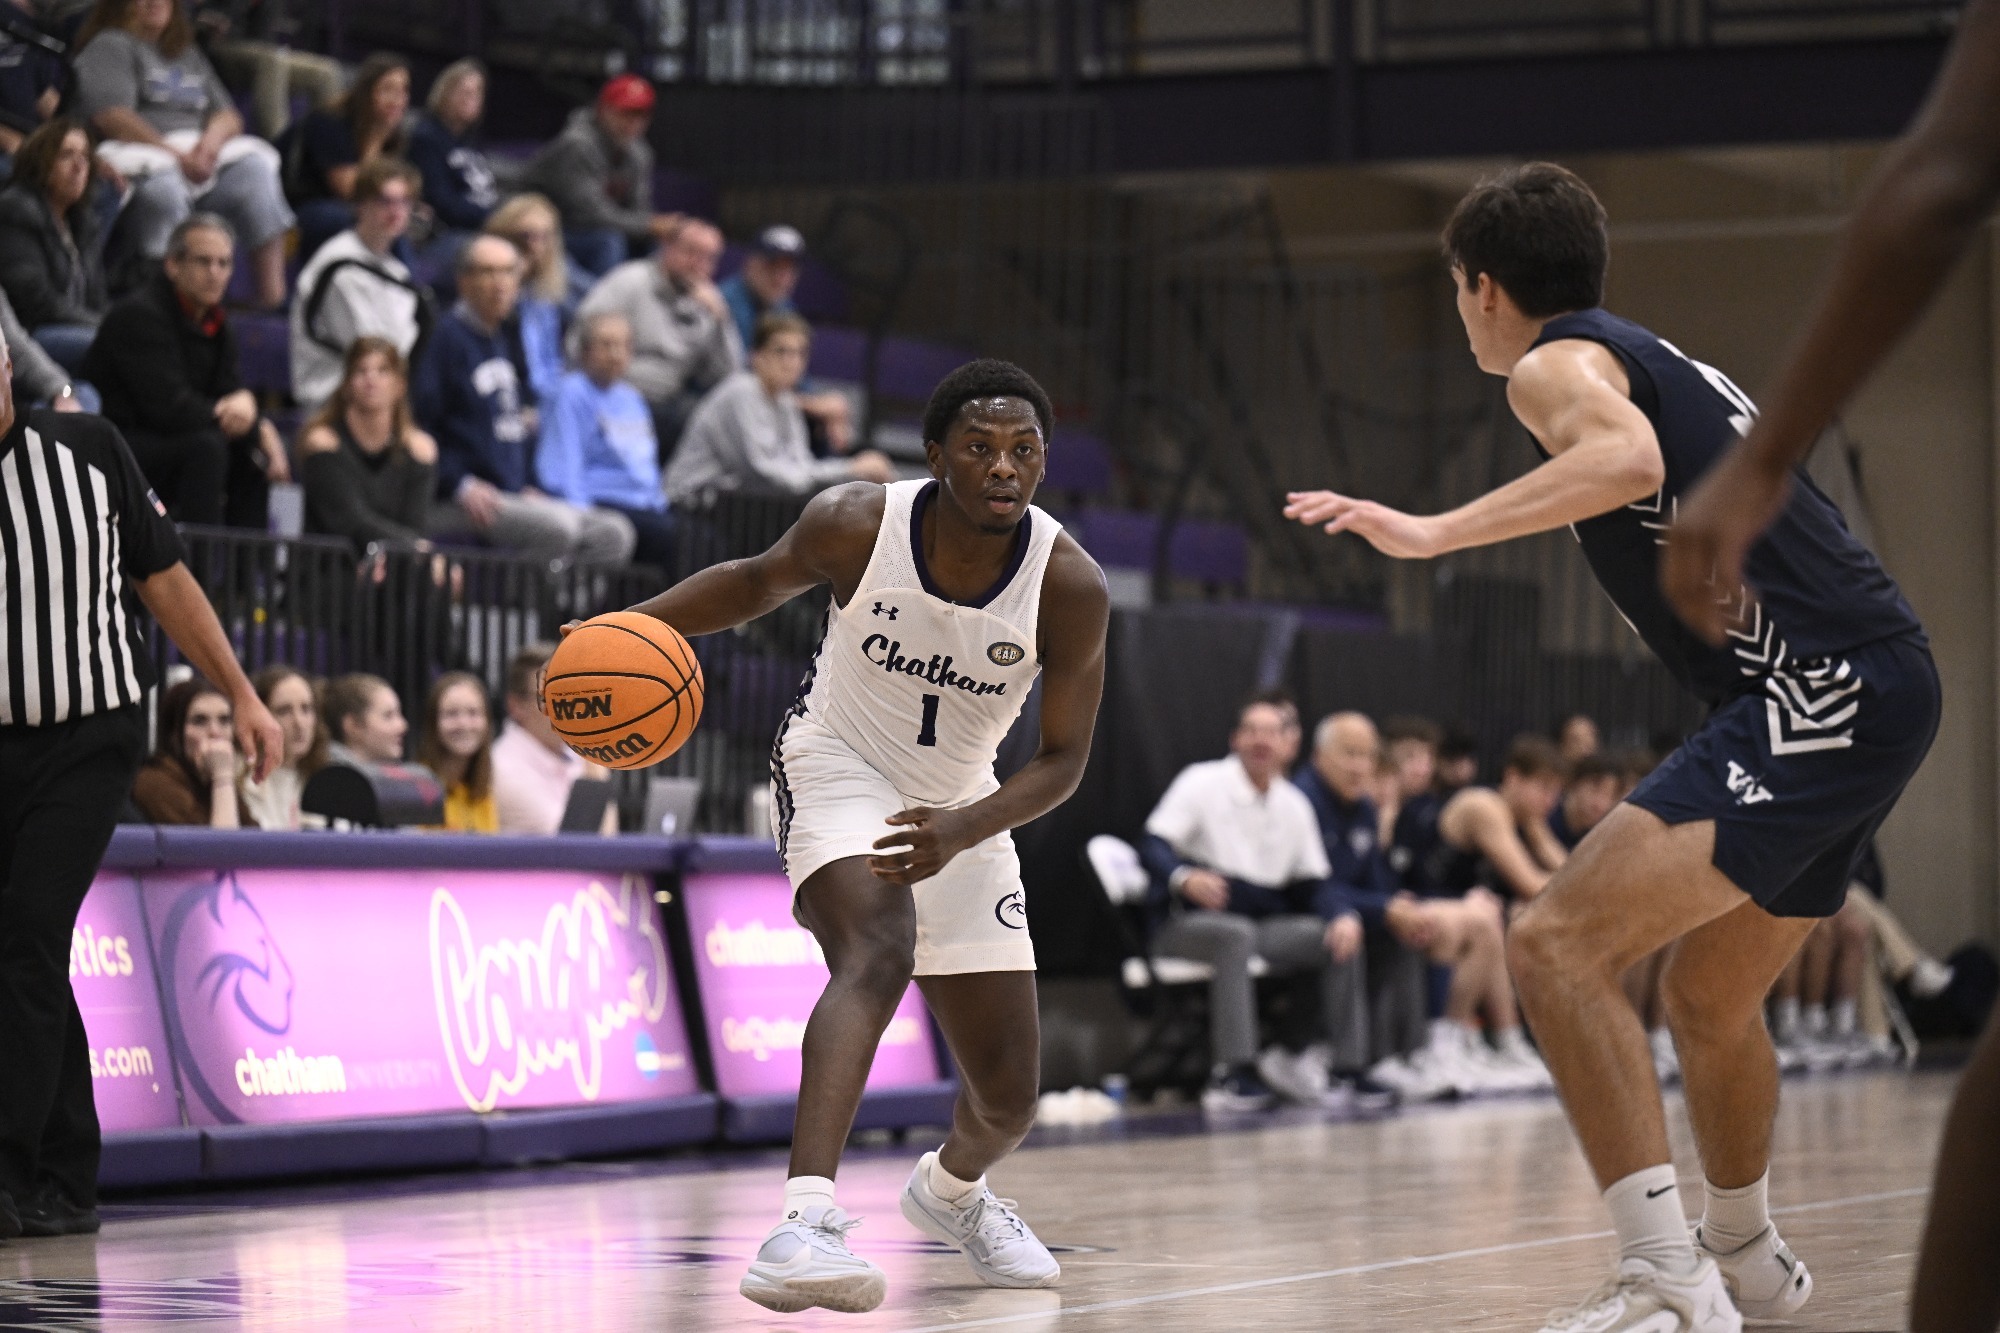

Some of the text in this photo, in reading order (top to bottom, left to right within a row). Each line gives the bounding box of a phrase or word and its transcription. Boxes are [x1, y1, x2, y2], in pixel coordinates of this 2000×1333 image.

[861, 633, 1007, 696] Chatham
[994, 648, 1018, 660] PAC
[552, 694, 612, 720] NCAA
[916, 693, 940, 747] 1
[234, 1046, 347, 1096] chatham
